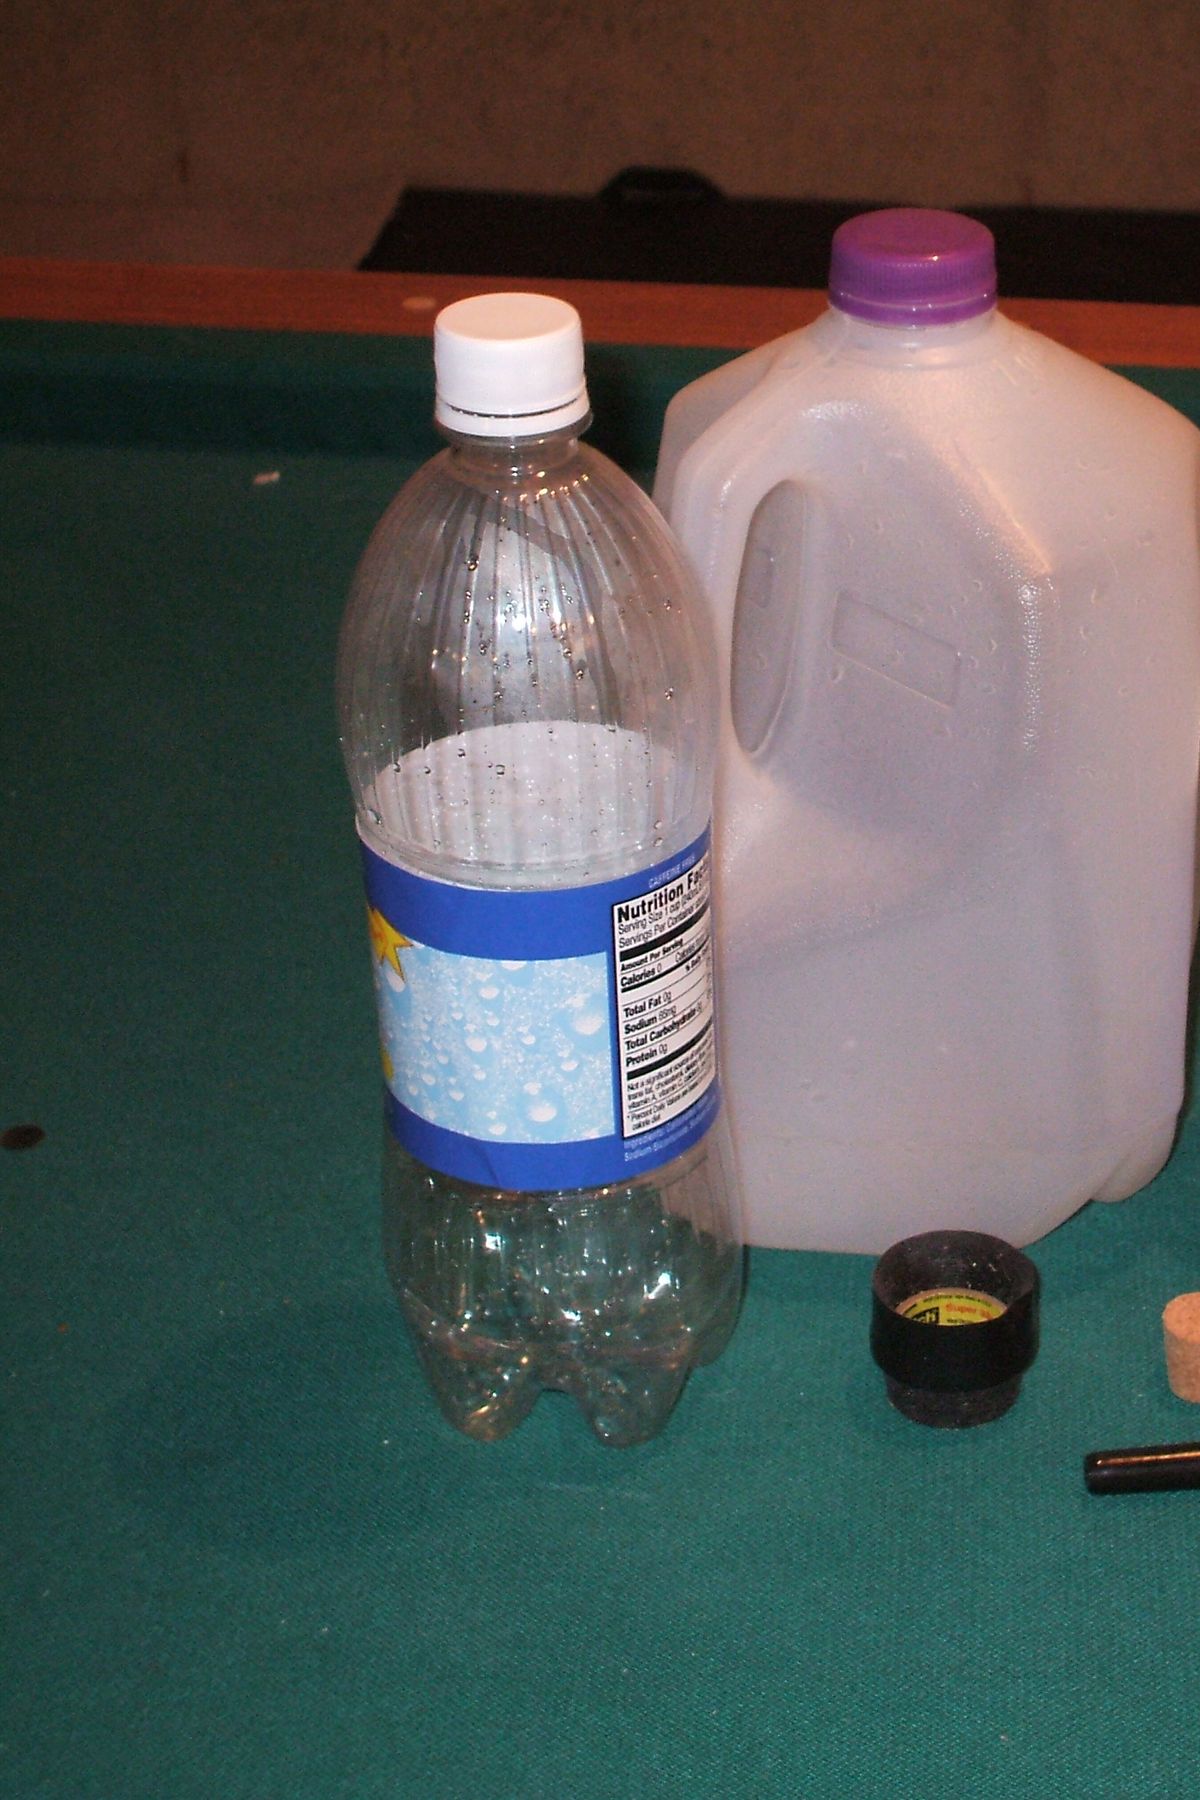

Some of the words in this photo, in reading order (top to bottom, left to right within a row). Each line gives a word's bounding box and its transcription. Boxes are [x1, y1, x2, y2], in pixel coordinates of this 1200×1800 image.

[617, 883, 684, 924] Nutrition
[619, 917, 647, 935] Serving
[648, 911, 663, 925] Size
[619, 929, 652, 948] Servings
[654, 922, 666, 935] Per
[621, 955, 648, 971] Amount
[650, 951, 660, 962] Per
[662, 938, 684, 956] Serving
[621, 966, 655, 987] Calories
[656, 963, 662, 973] 0
[623, 1002, 646, 1018] Total
[648, 995, 662, 1011] Fat
[662, 991, 672, 1004] 0g
[624, 1015, 657, 1035] Sodium
[625, 1035, 648, 1051] Total
[649, 1007, 697, 1042] Carbohydrate
[626, 1048, 657, 1067] Protein
[659, 1043, 668, 1055] 0g
